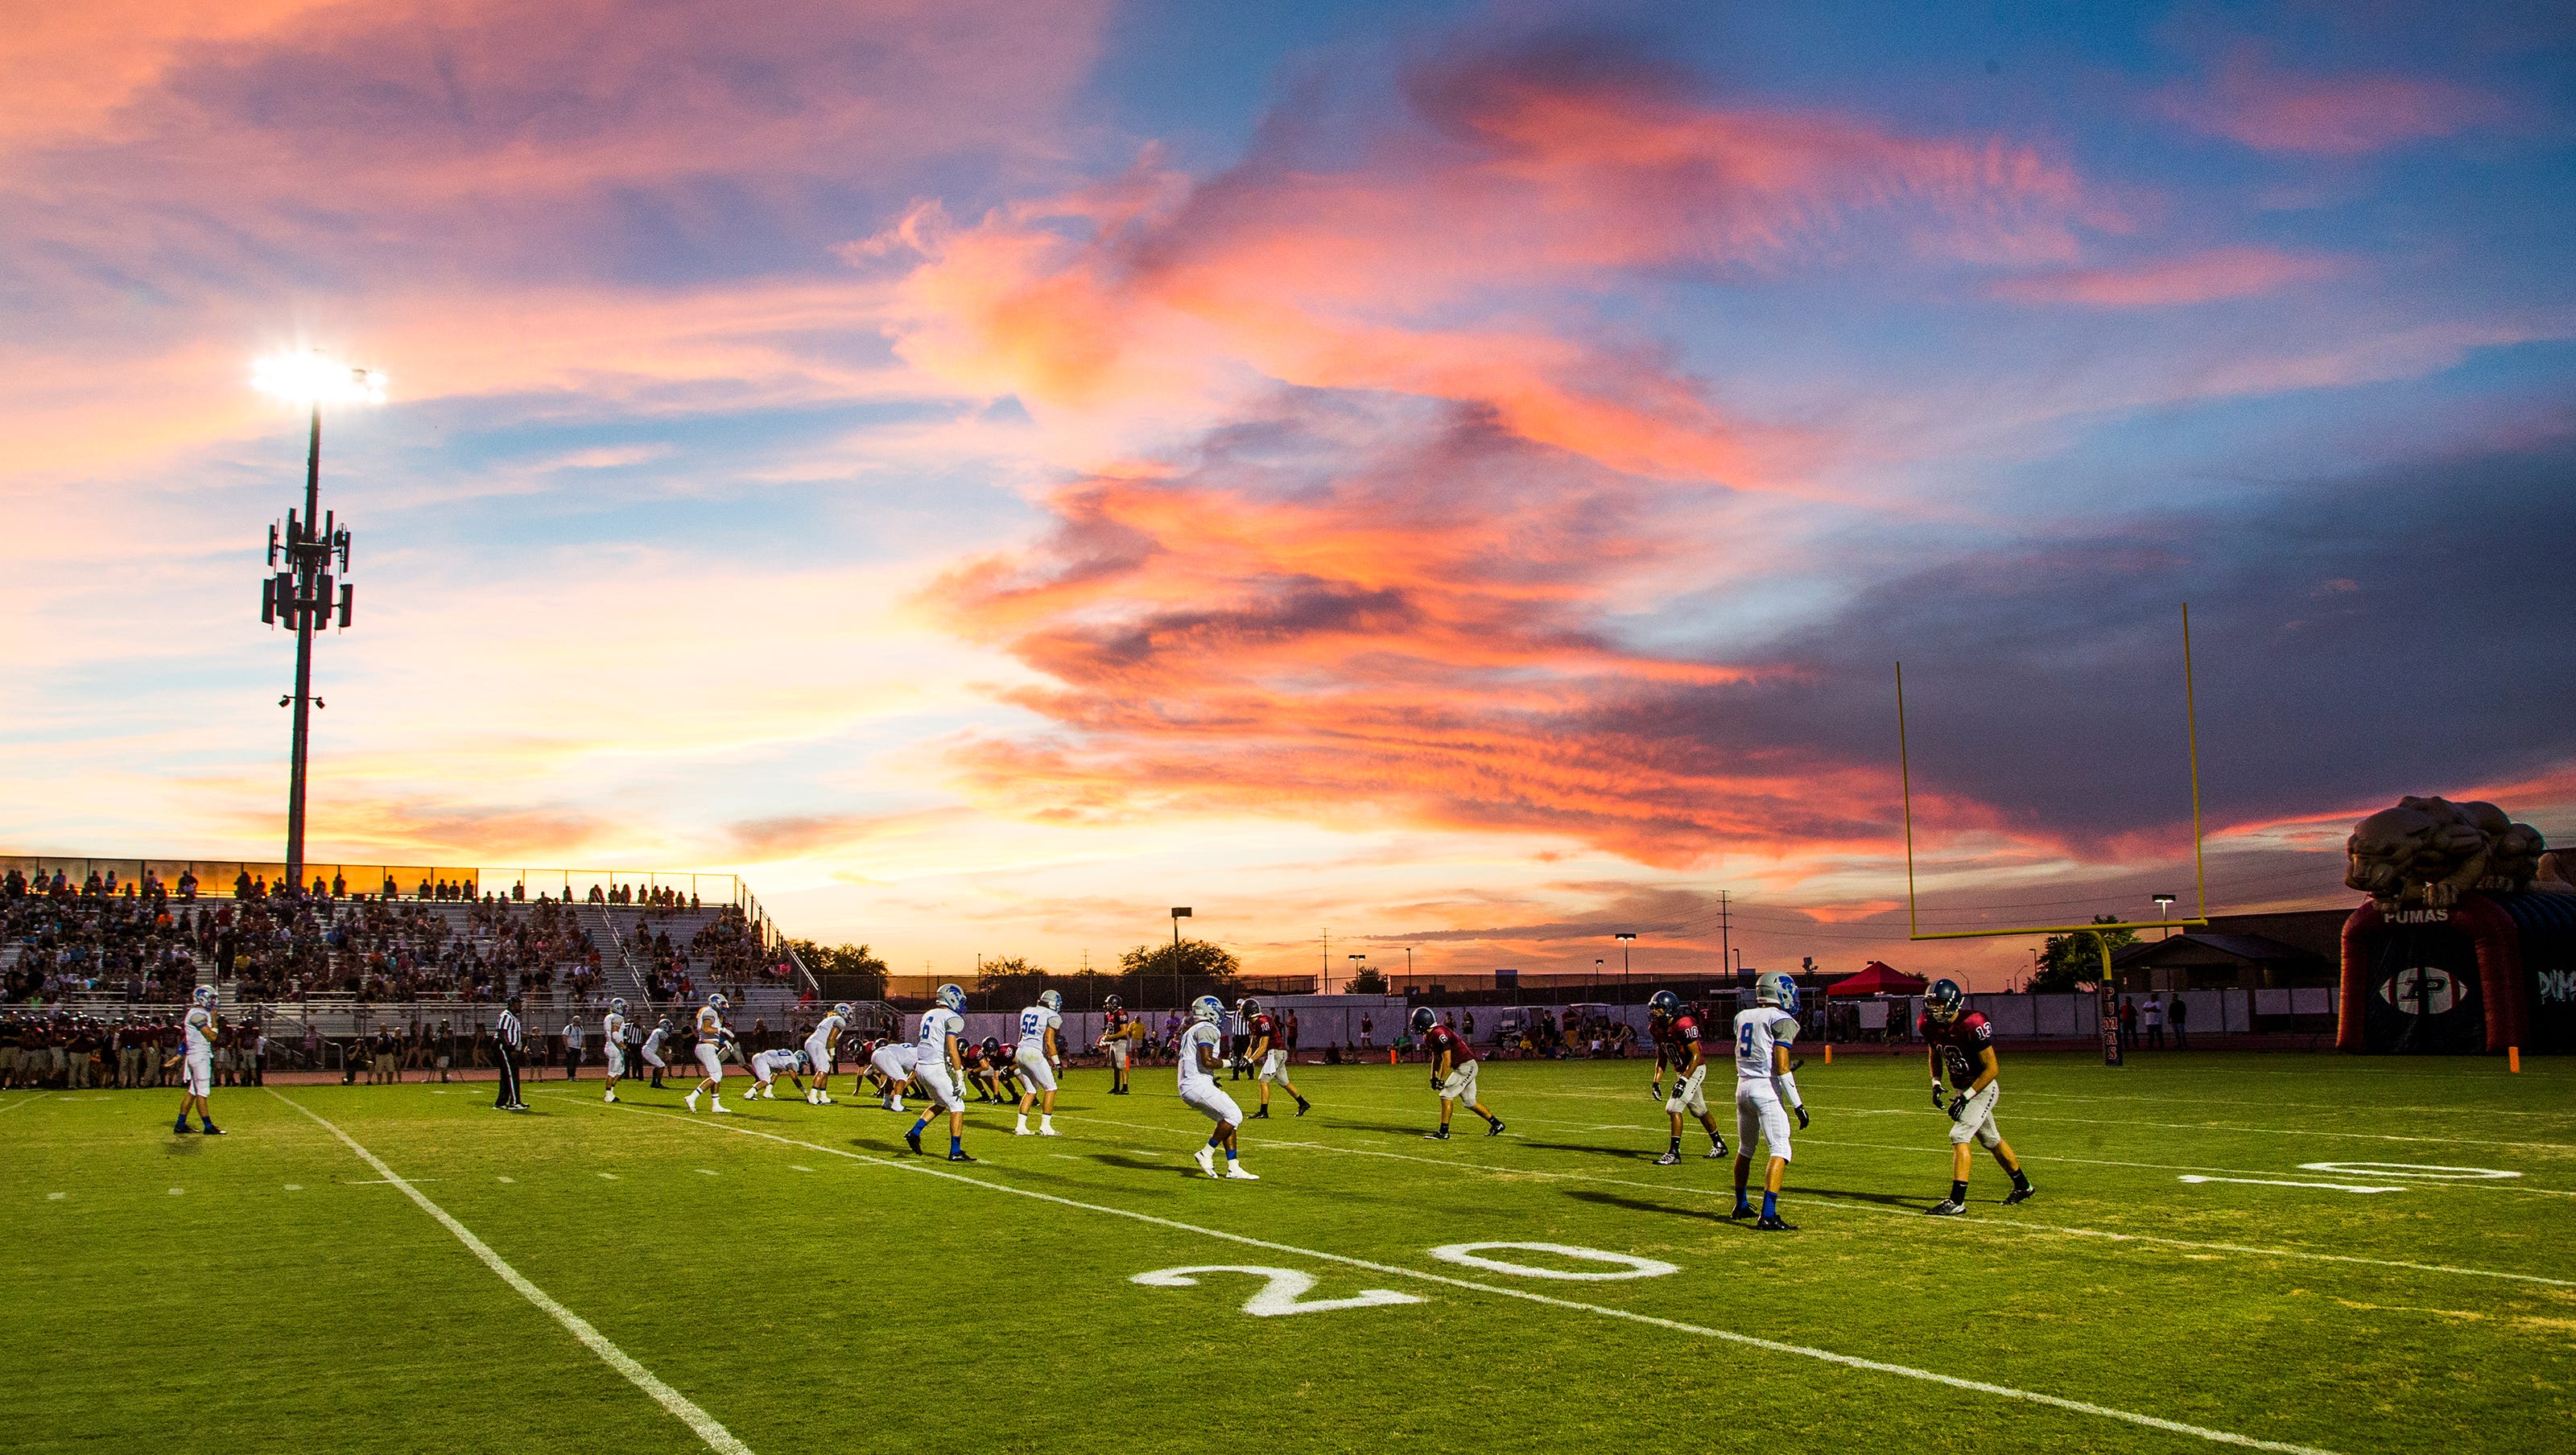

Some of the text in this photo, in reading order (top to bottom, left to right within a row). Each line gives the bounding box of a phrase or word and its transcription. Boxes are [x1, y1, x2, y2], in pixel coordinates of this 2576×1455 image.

[2384, 909, 2449, 924] PUMAS
[921, 1016, 934, 1040] 6
[1022, 1013, 1038, 1035] 52
[1685, 1025, 1699, 1038] 10
[1975, 1021, 1992, 1041] 13
[2103, 987, 2118, 1060] PUMAS
[1740, 1022, 1753, 1057] 9
